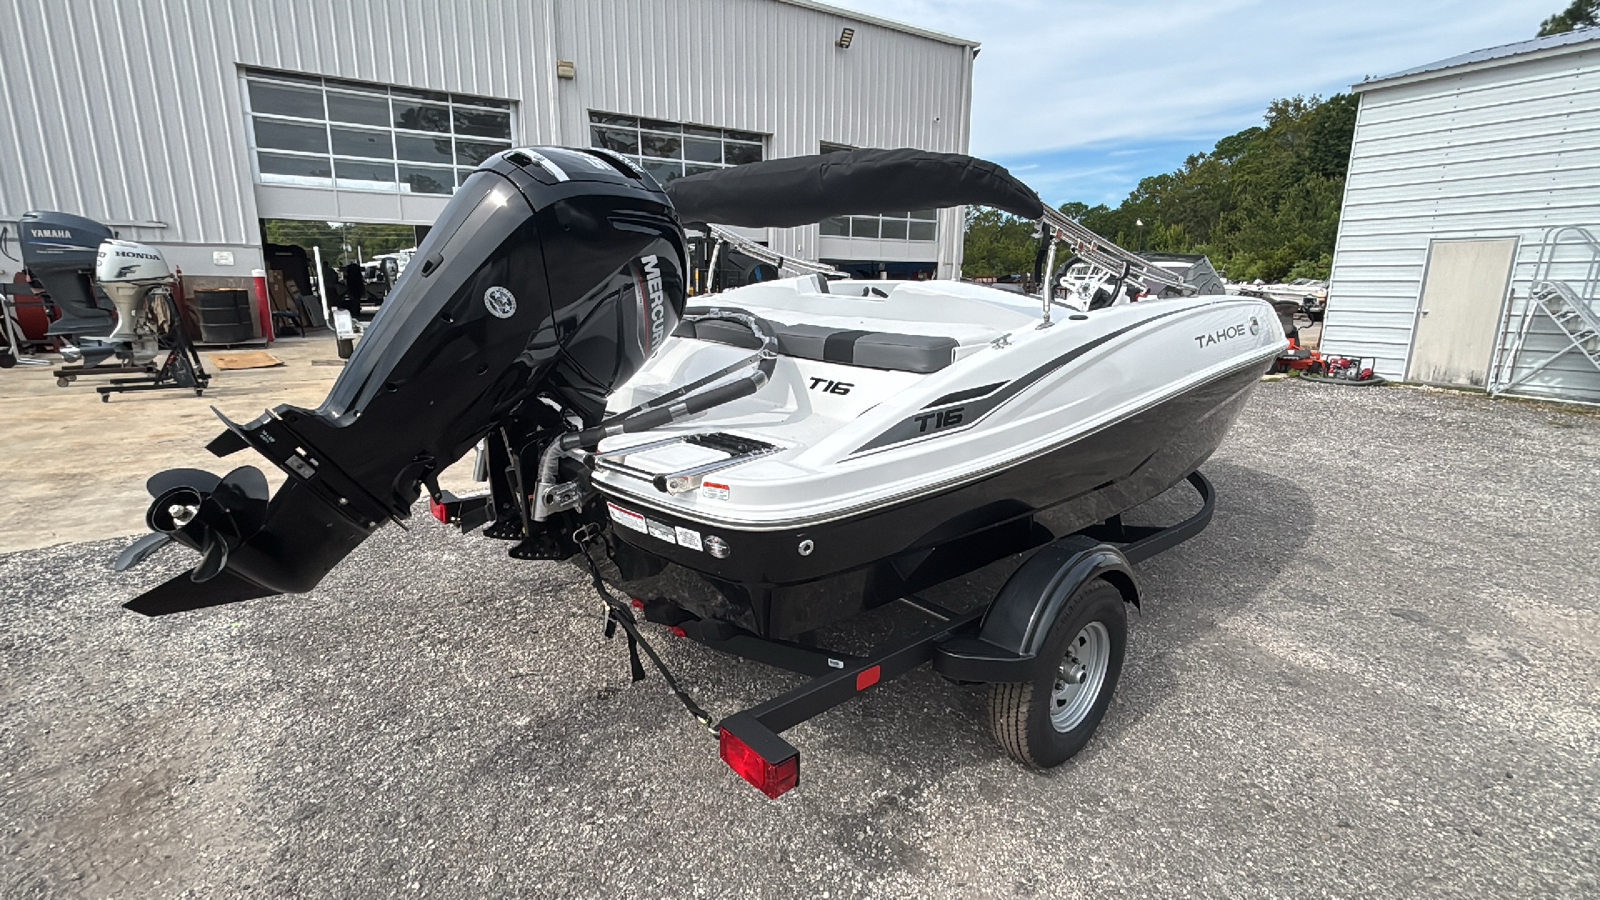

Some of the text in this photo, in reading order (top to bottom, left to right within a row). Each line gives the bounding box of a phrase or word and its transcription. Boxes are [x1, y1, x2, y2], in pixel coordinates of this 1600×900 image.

[31, 229, 72, 239] YAMAHA
[115, 251, 161, 261] HONDA
[1194, 324, 1246, 349] TAHOE
[809, 376, 855, 396] T16
[914, 407, 965, 433] T16
